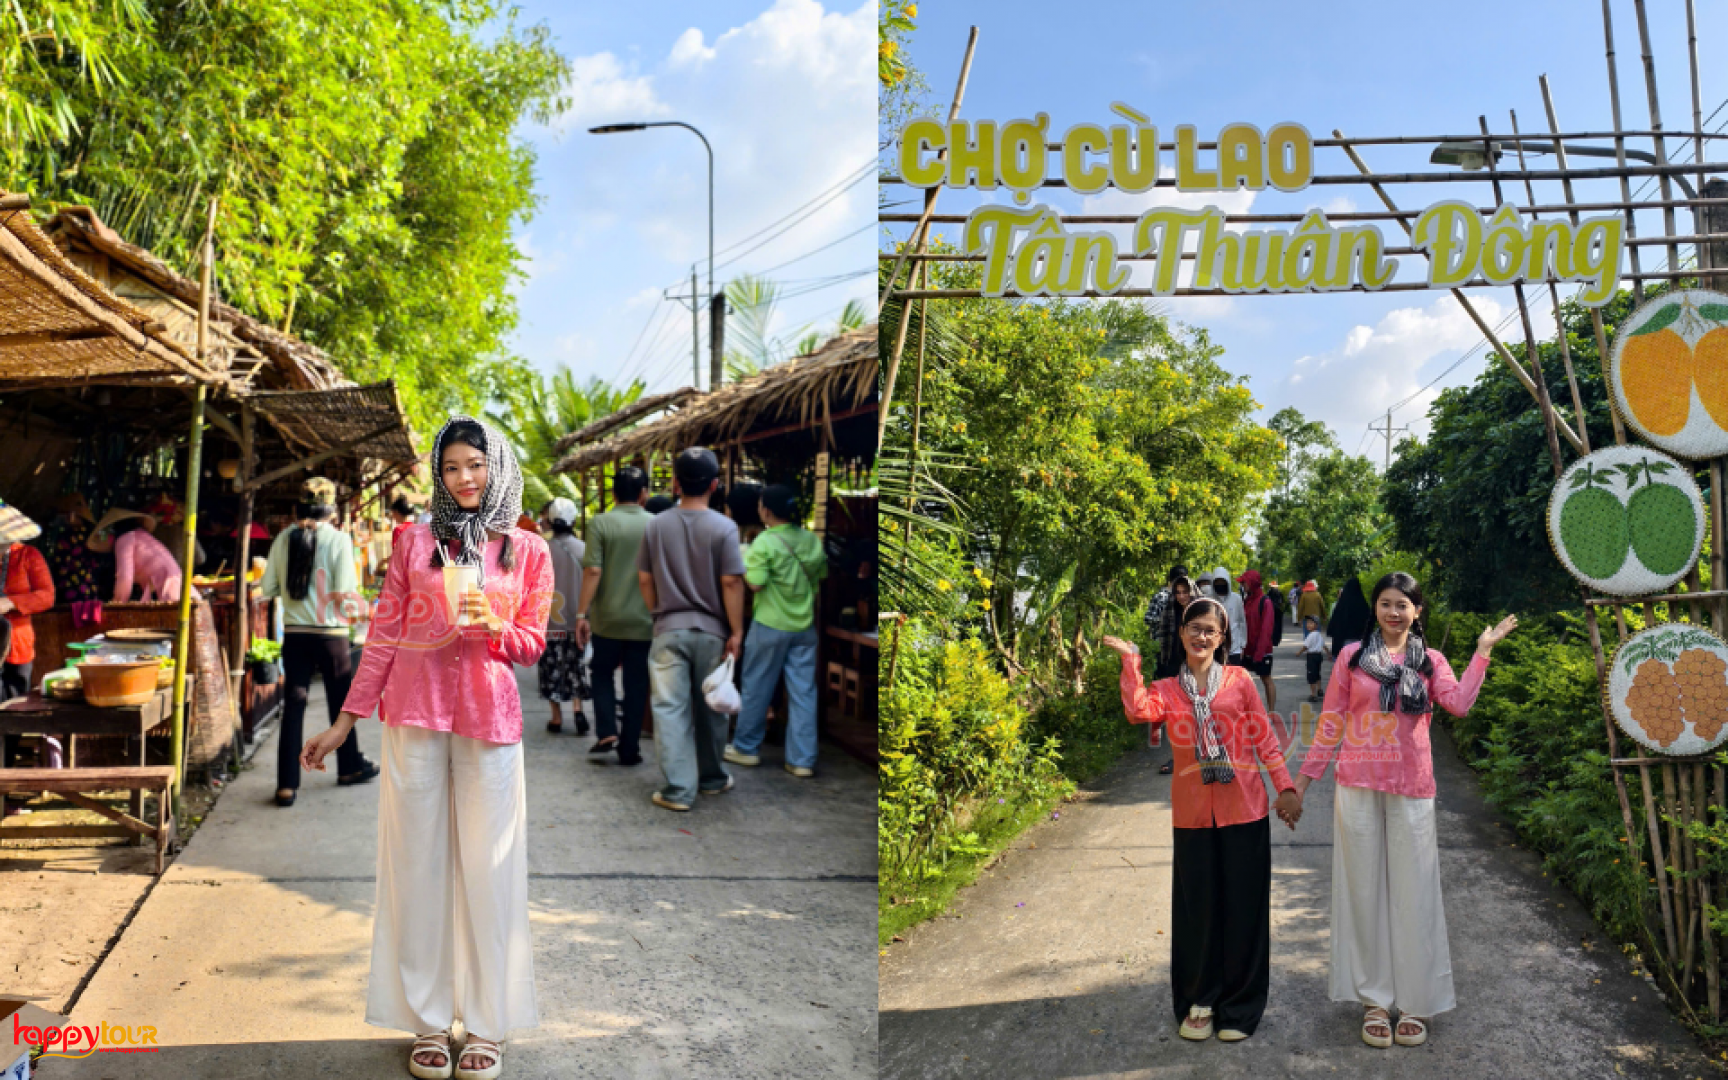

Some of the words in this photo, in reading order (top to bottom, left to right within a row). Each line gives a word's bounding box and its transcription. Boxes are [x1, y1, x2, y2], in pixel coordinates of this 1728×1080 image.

[900, 112, 1049, 204] CHỢ
[1062, 101, 1159, 194] CÙ
[1175, 122, 1314, 192] LAO
[963, 204, 1132, 297] Tân
[1134, 204, 1399, 297] Thuân
[1411, 199, 1626, 307] Đông
